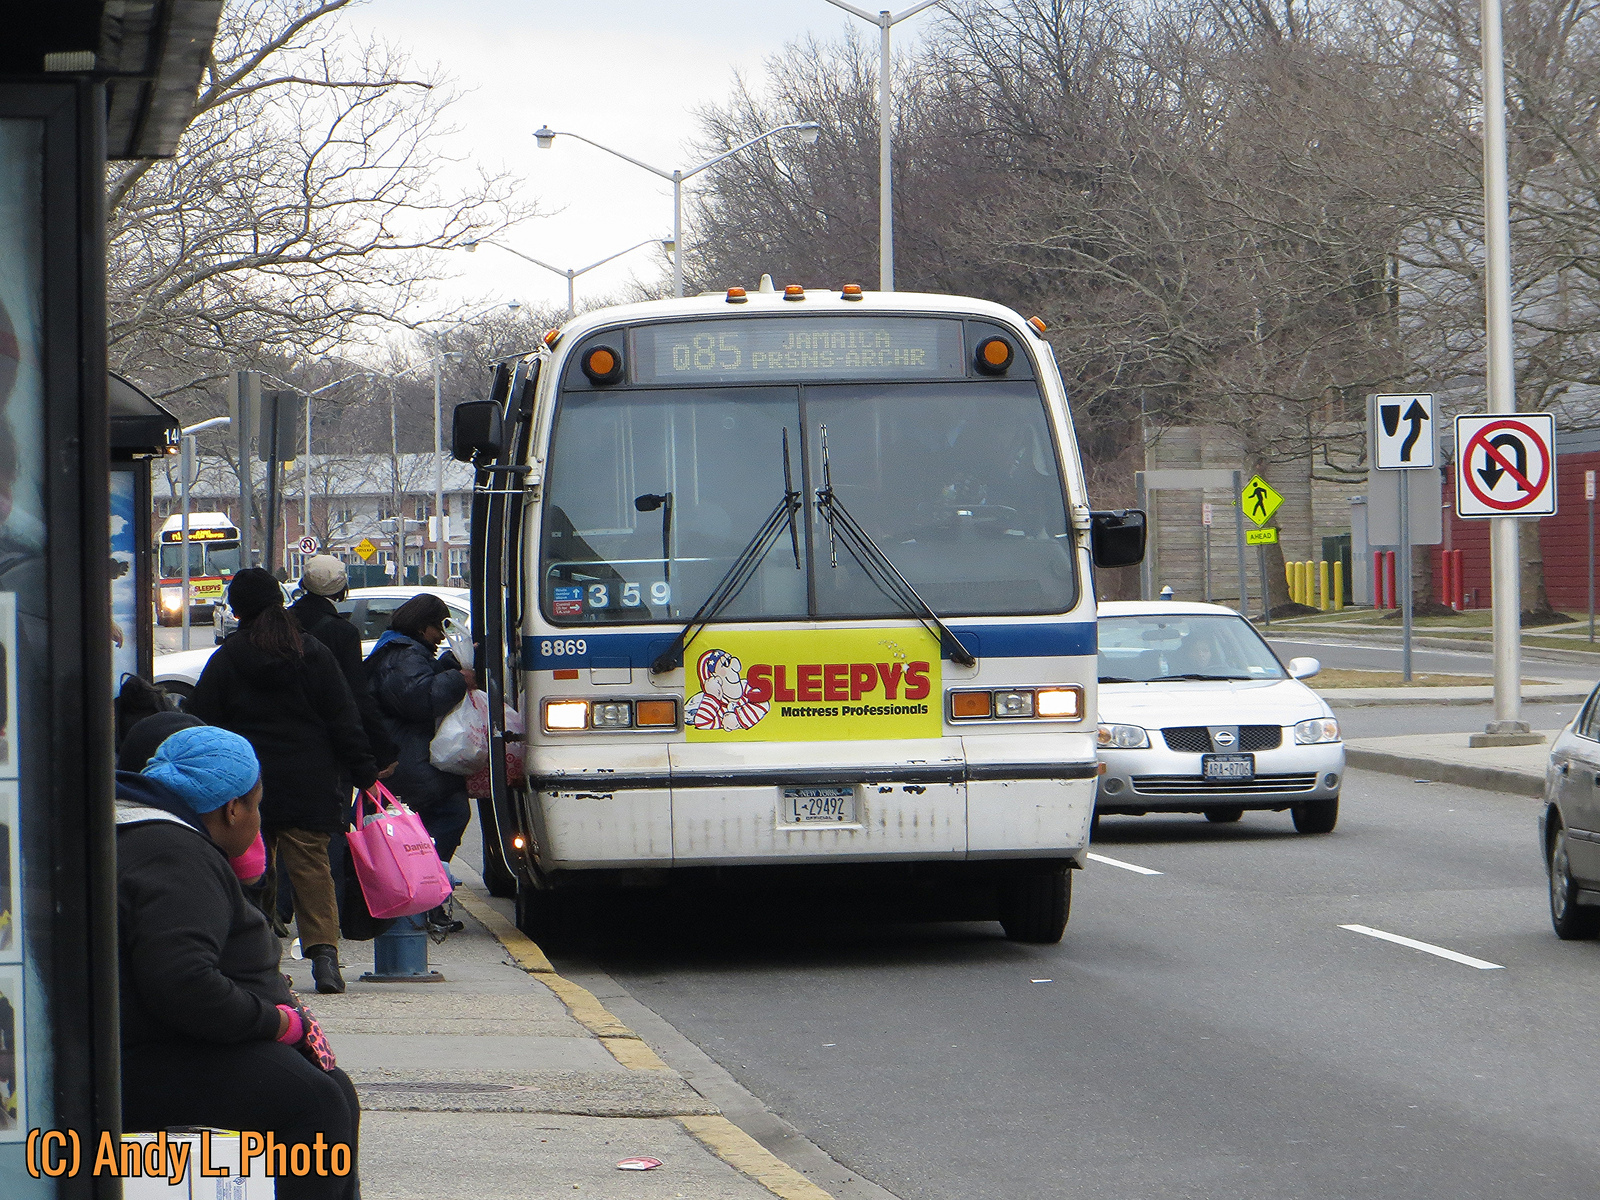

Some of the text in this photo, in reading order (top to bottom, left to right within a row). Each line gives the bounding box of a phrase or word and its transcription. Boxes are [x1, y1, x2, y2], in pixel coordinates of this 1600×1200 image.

[782, 329, 891, 349] JAMAICA
[673, 332, 742, 370] Q85
[1250, 532, 1272, 540] AHEAD
[541, 639, 588, 656] 8869
[781, 703, 928, 717] Mattress Professionals
[801, 789, 837, 797] NEW YORK
